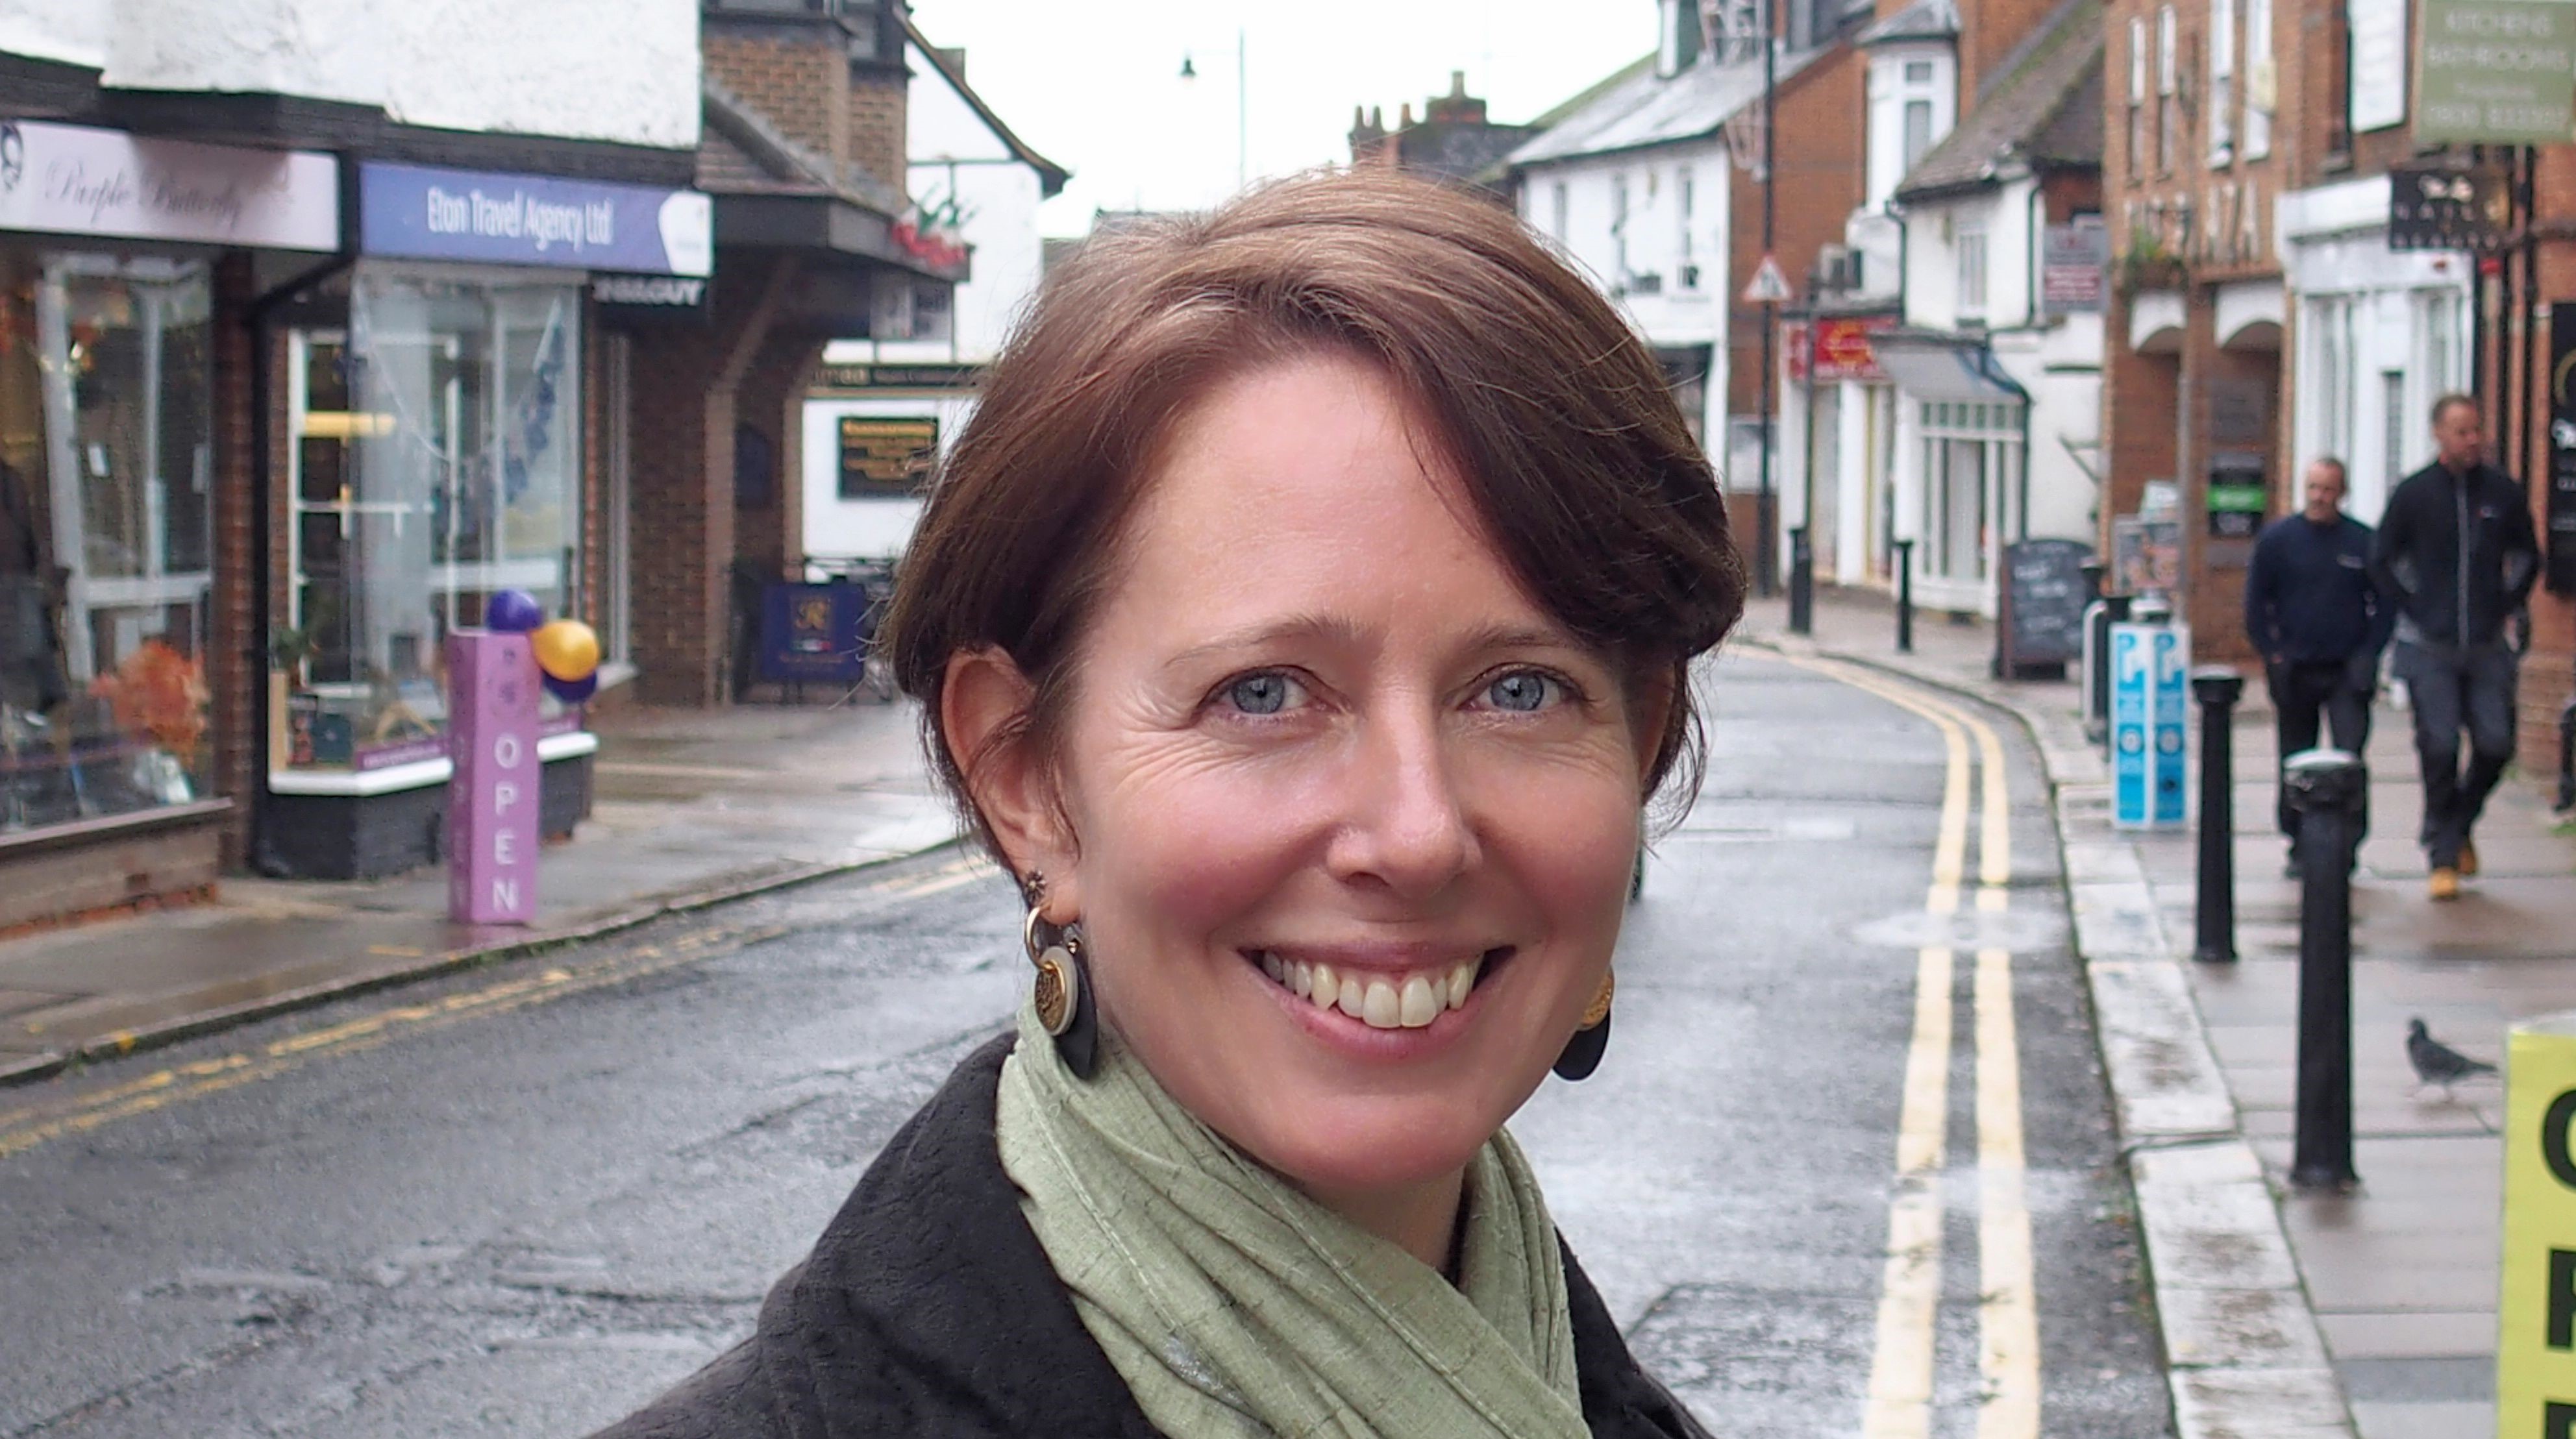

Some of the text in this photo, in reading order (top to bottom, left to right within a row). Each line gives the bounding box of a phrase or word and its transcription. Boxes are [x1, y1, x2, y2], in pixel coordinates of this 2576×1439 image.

[427, 186, 614, 252] Eton Travel Agency Ltd
[493, 733, 521, 913] OPEN
